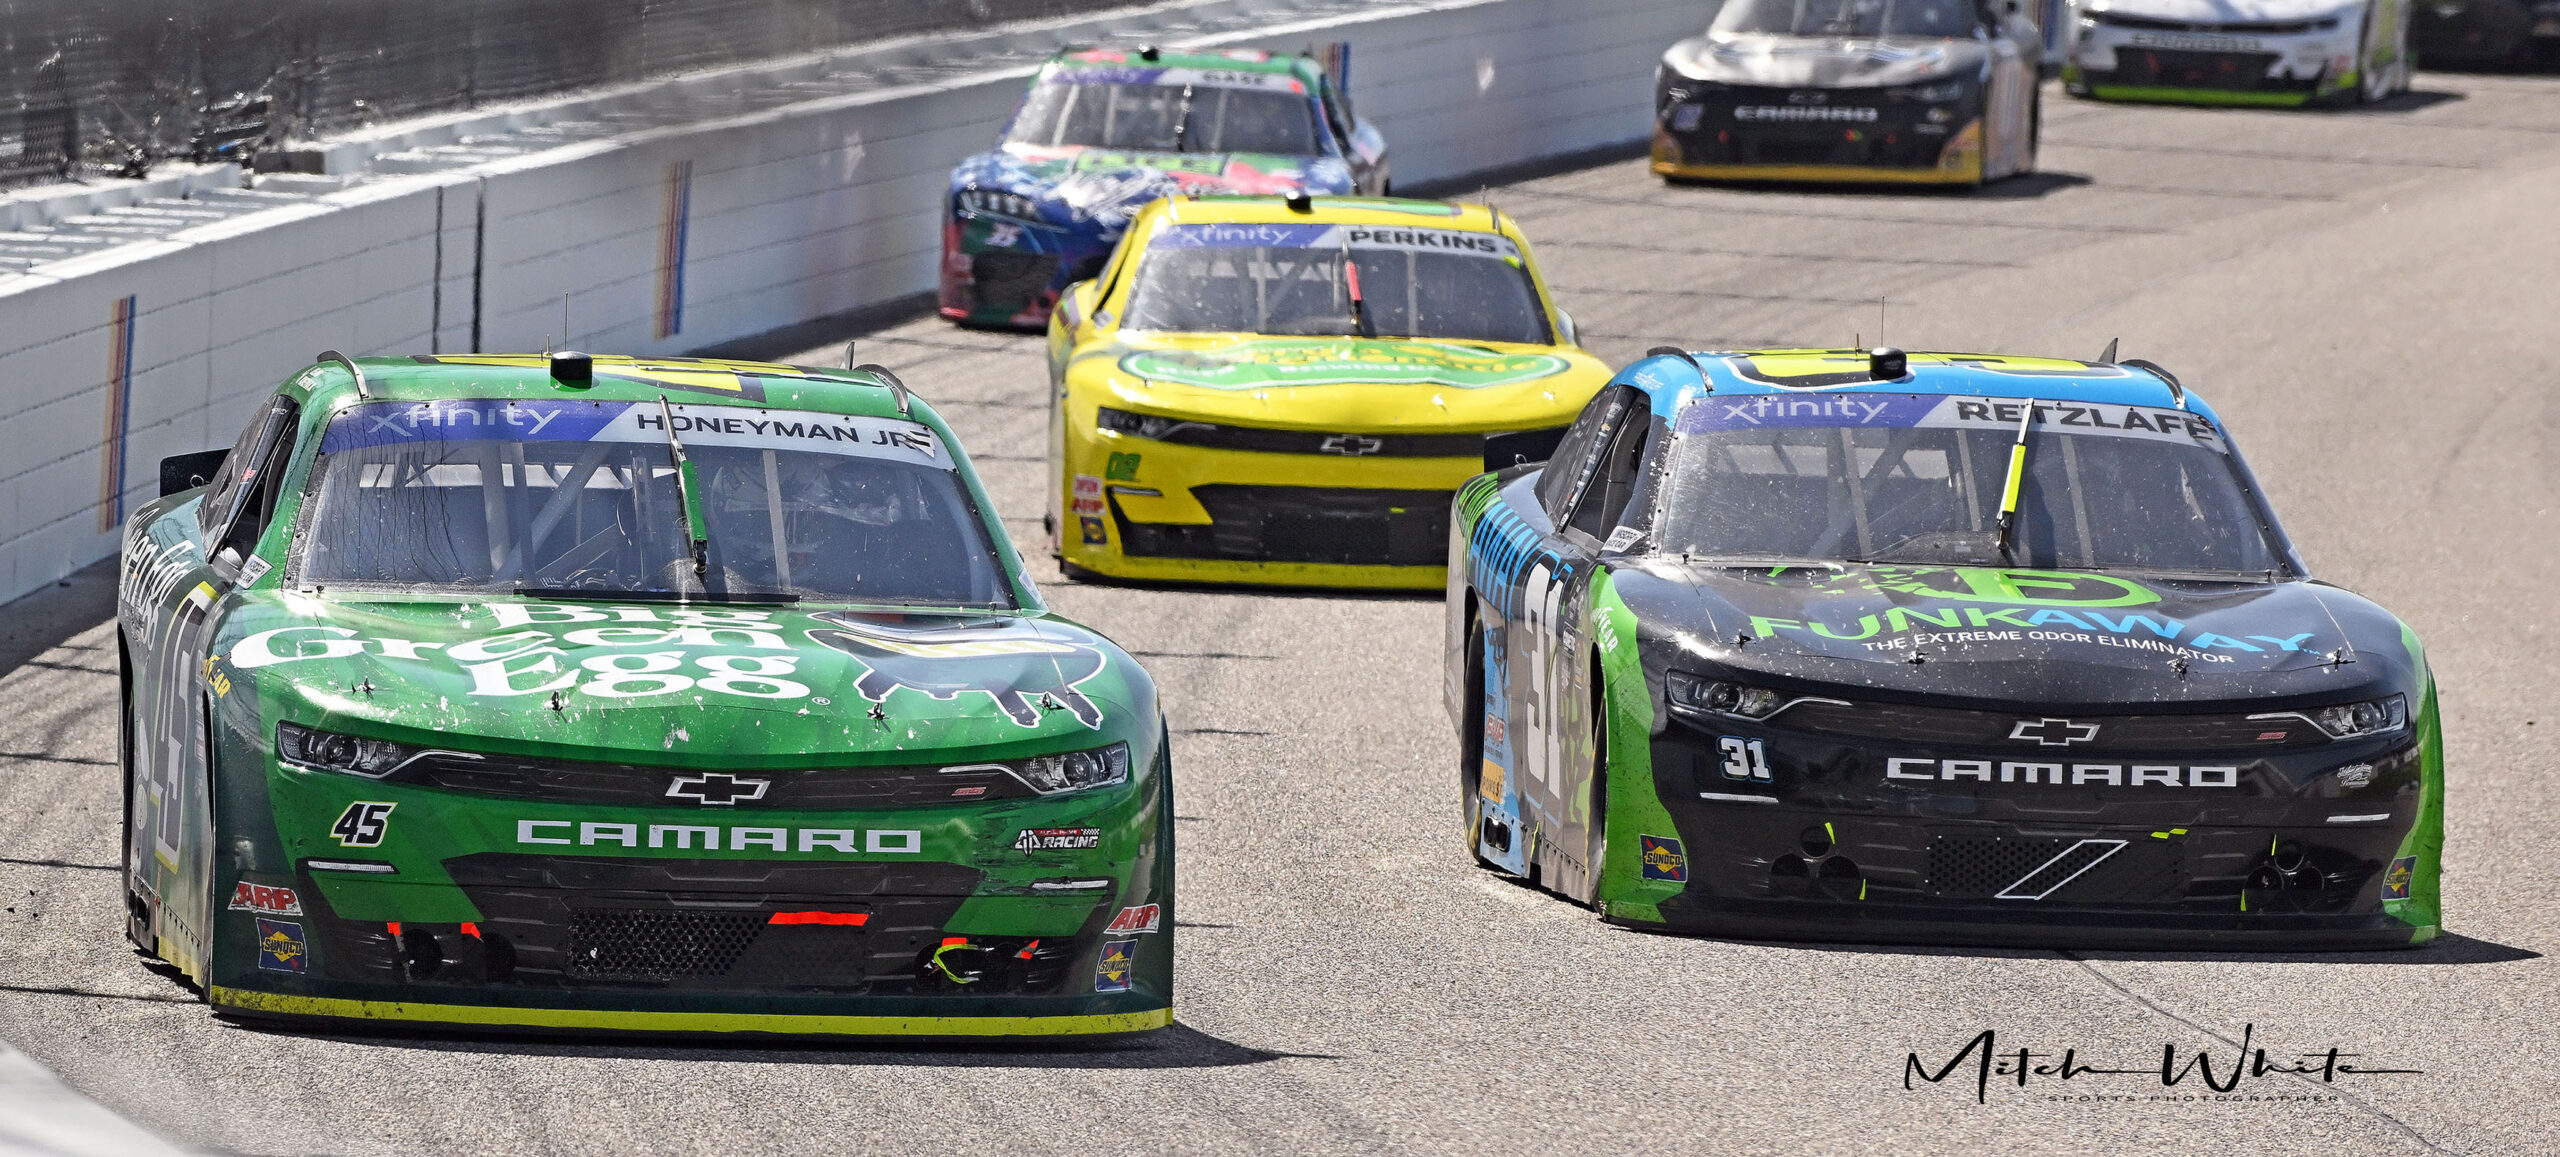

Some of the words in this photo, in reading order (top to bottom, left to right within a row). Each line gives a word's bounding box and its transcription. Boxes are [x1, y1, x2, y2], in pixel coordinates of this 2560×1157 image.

[1180, 225, 1293, 247] xfinity
[1351, 229, 1497, 253] PERKINS
[367, 401, 562, 437] xfinity
[1723, 394, 1889, 425] xfinity
[1956, 400, 2214, 441] RETZLAFF
[637, 413, 860, 444] HONEYMAN
[482, 602, 784, 631] Big
[1749, 607, 2316, 653] FUNKAWAY
[229, 626, 800, 669] Green
[1860, 635, 1907, 653] THE
[1913, 630, 2021, 645] EXTREME
[2027, 629, 2092, 645] ODOR
[2097, 634, 2237, 665] ELIMINATOR
[460, 646, 811, 699] Egg
[1718, 737, 1774, 783] 31
[1886, 757, 2237, 788] CAMARO
[331, 802, 395, 847] 45
[516, 820, 922, 854] CAMARO
[1042, 835, 1099, 848] RACING
[1643, 850, 1684, 868] SUNOCO
[236, 883, 299, 912] ARP
[1110, 905, 1160, 931] ARP
[263, 936, 305, 957] SUNOCO
[1098, 959, 1130, 974] SUNOCO
